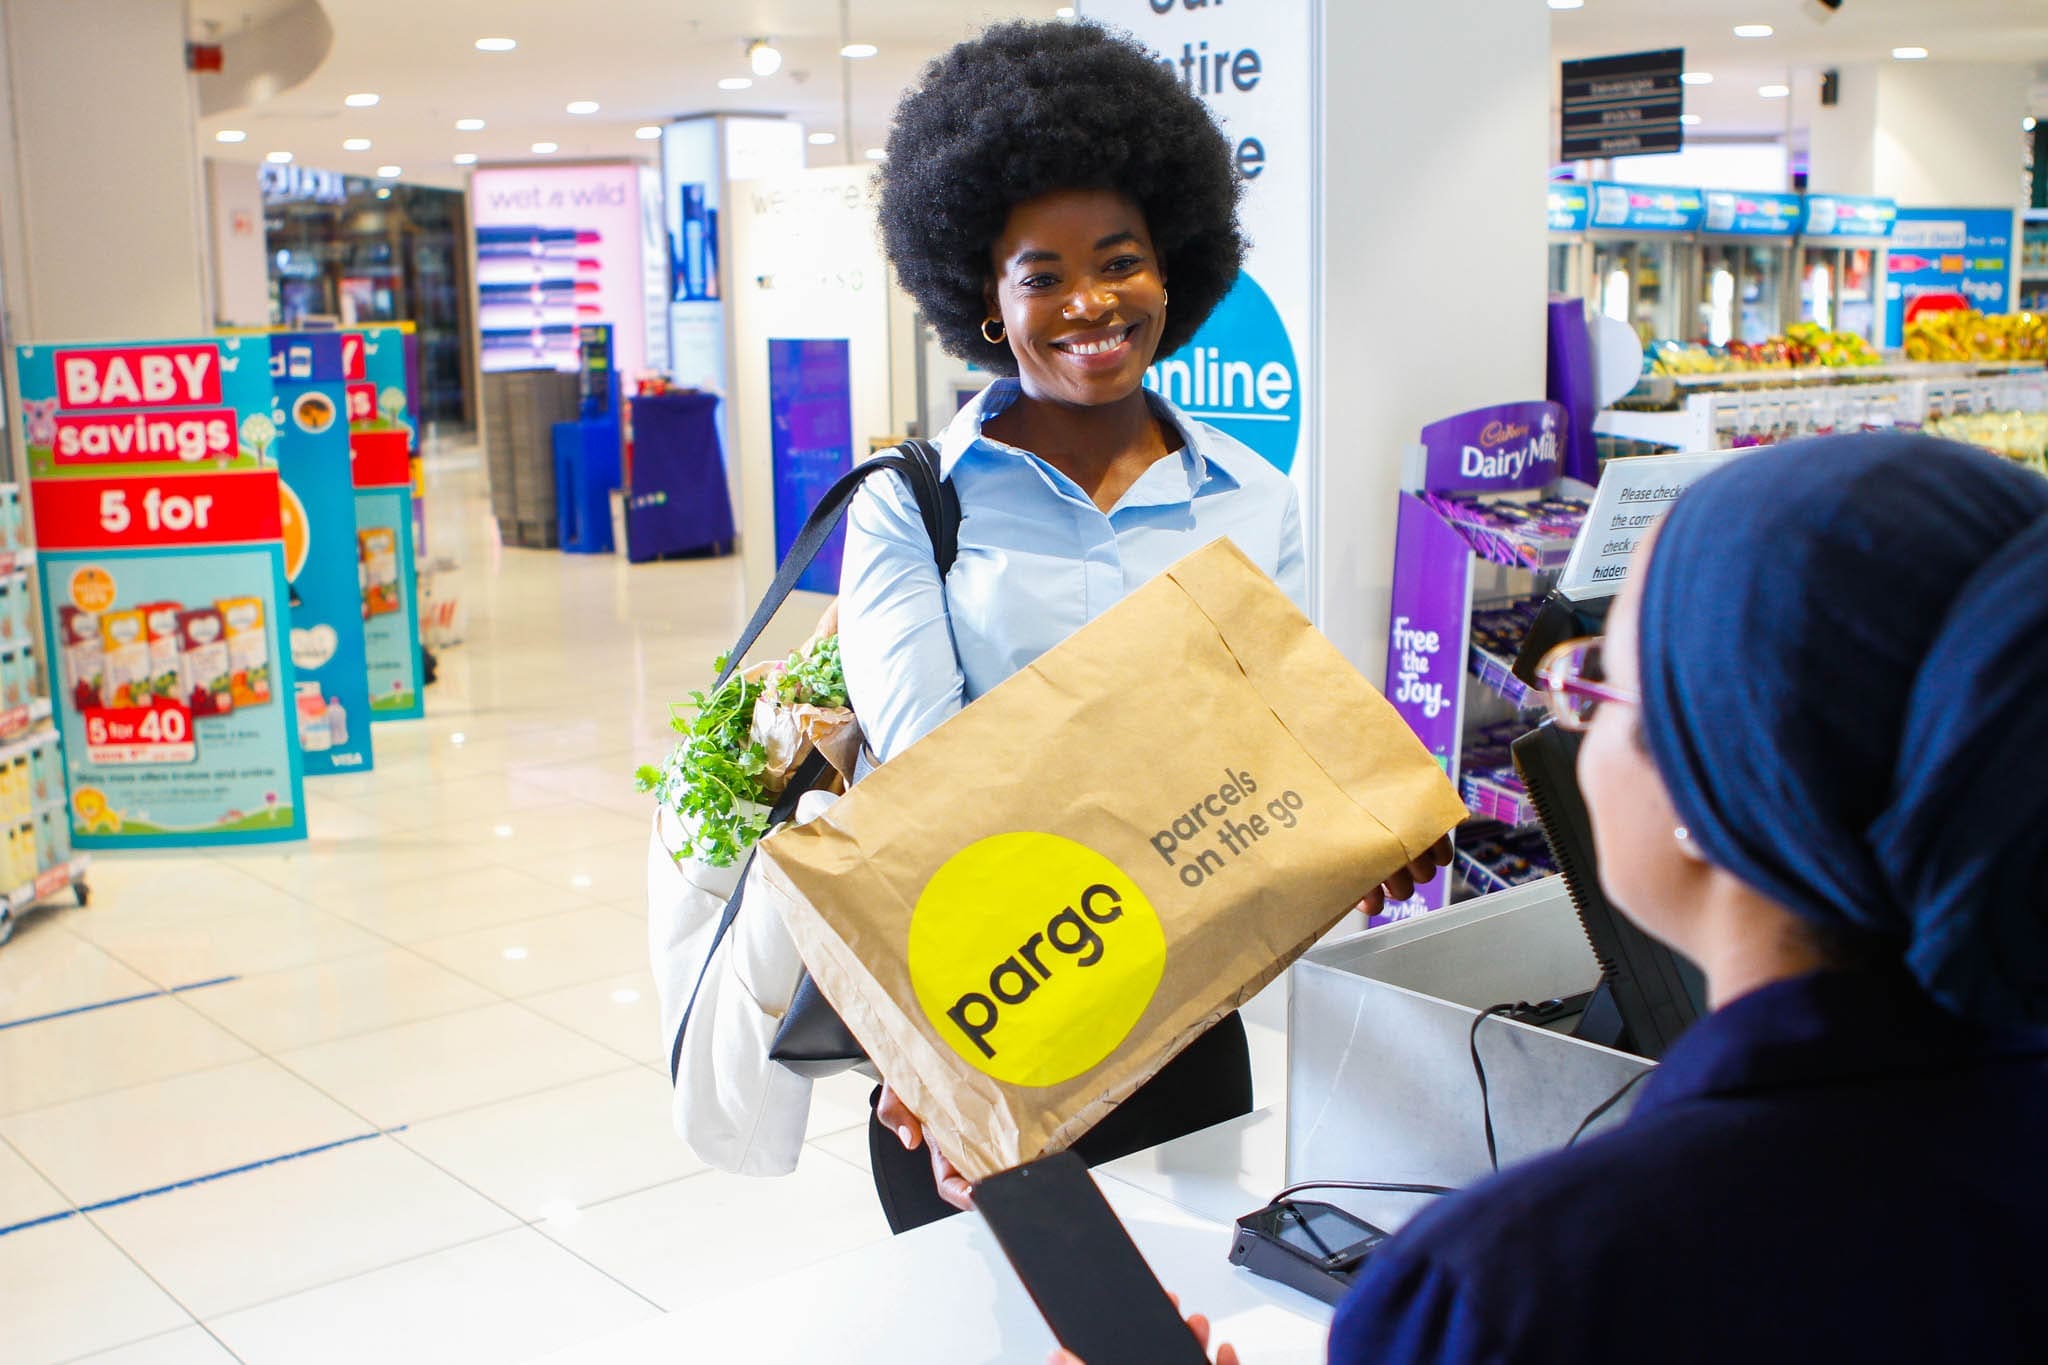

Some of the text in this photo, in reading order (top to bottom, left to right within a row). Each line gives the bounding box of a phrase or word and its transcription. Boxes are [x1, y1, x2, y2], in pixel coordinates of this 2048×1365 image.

[64, 353, 212, 405] BABY
[58, 414, 230, 462] savings
[1461, 429, 1557, 479] Dairy Milk
[100, 487, 213, 533] 5 for
[1620, 487, 1652, 501] Please
[1653, 484, 1682, 499] check
[1611, 514, 1628, 527] the
[1603, 538, 1630, 553] check
[1593, 566, 1627, 579] hidden
[1394, 616, 1440, 653] Free
[1402, 650, 1430, 674] the
[89, 717, 107, 743] 5
[109, 722, 135, 738] for
[139, 708, 186, 742] 40
[1150, 767, 1257, 867] parcels
[1179, 790, 1304, 888] on the go
[947, 883, 1125, 1059] pargo
